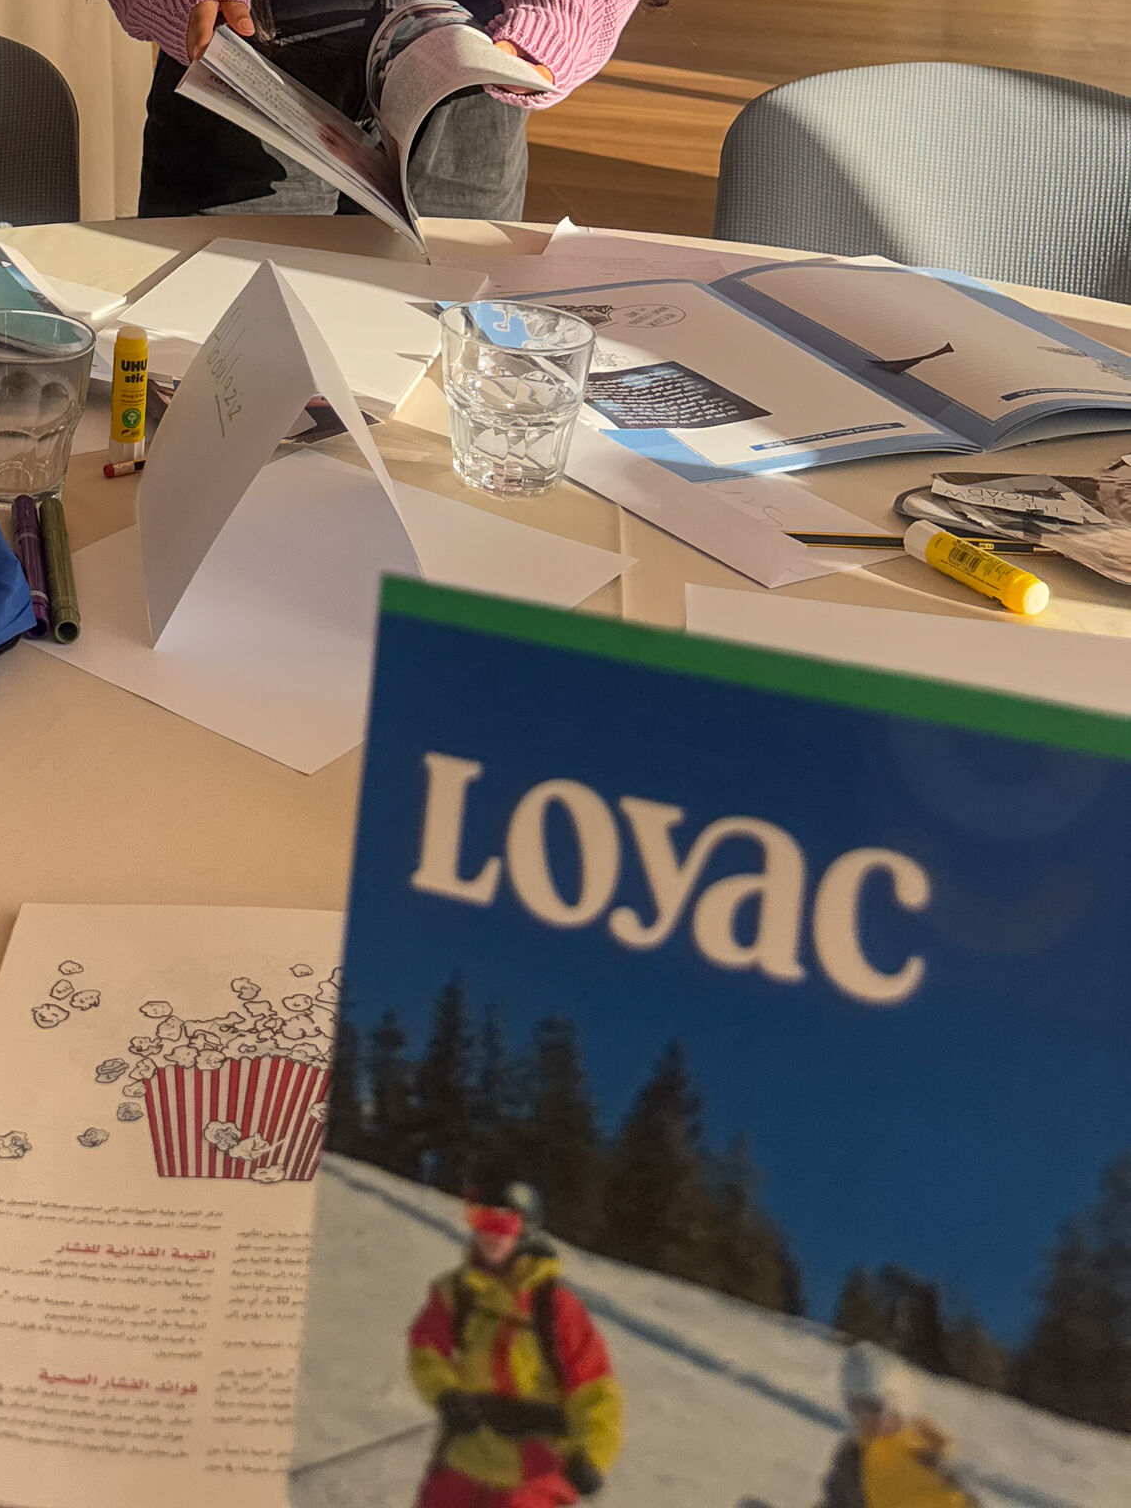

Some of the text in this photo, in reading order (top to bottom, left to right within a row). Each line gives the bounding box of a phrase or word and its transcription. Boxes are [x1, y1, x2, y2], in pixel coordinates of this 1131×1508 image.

[121, 359, 147, 372] UHU
[125, 373, 144, 383] stic
[944, 488, 1011, 508] SLOW
[967, 487, 1035, 505] ROAD
[411, 752, 933, 1003] Loyac
[56, 1241, 216, 1263] القيمة الغذائية للفشار
[37, 1367, 198, 1396] فوائد الفشار الصحية
